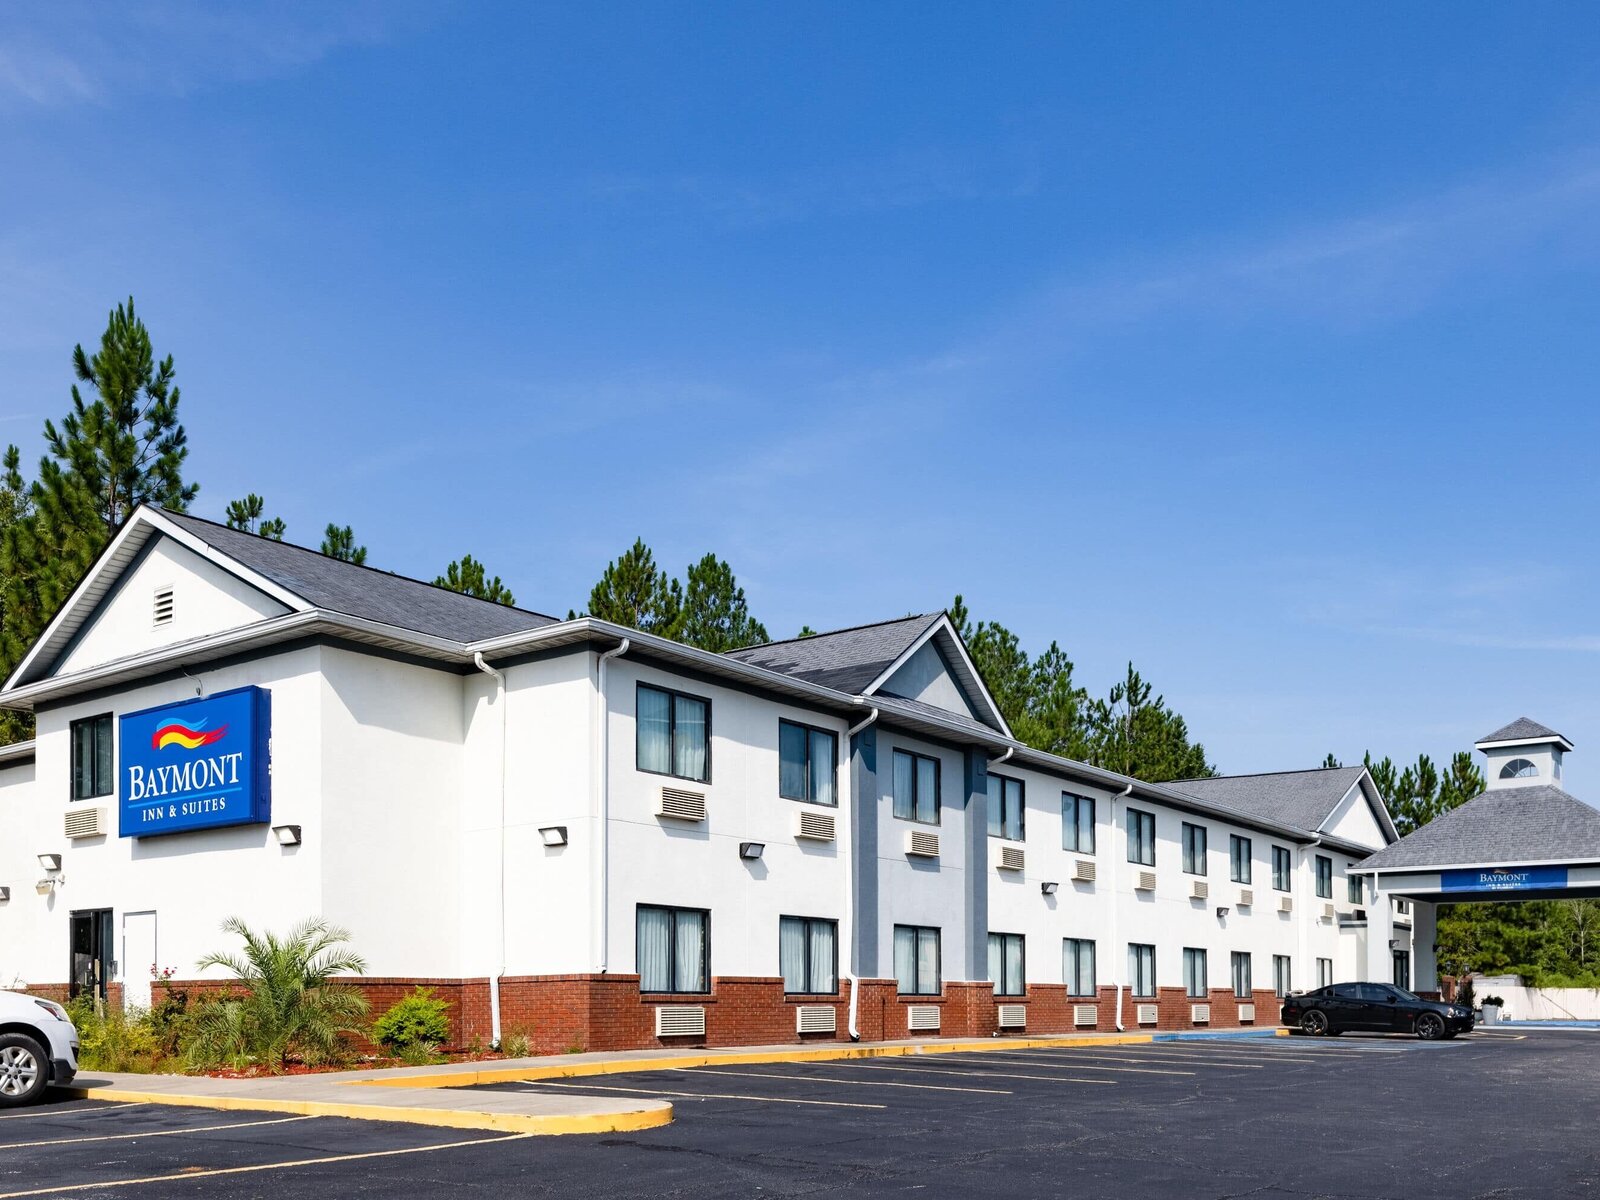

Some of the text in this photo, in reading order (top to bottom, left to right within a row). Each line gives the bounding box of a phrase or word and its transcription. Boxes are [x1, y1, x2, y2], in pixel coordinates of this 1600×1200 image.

[129, 752, 242, 801] BAYMONT
[142, 797, 226, 821] INN & SUITES
[1480, 873, 1528, 882] BAYMONT
